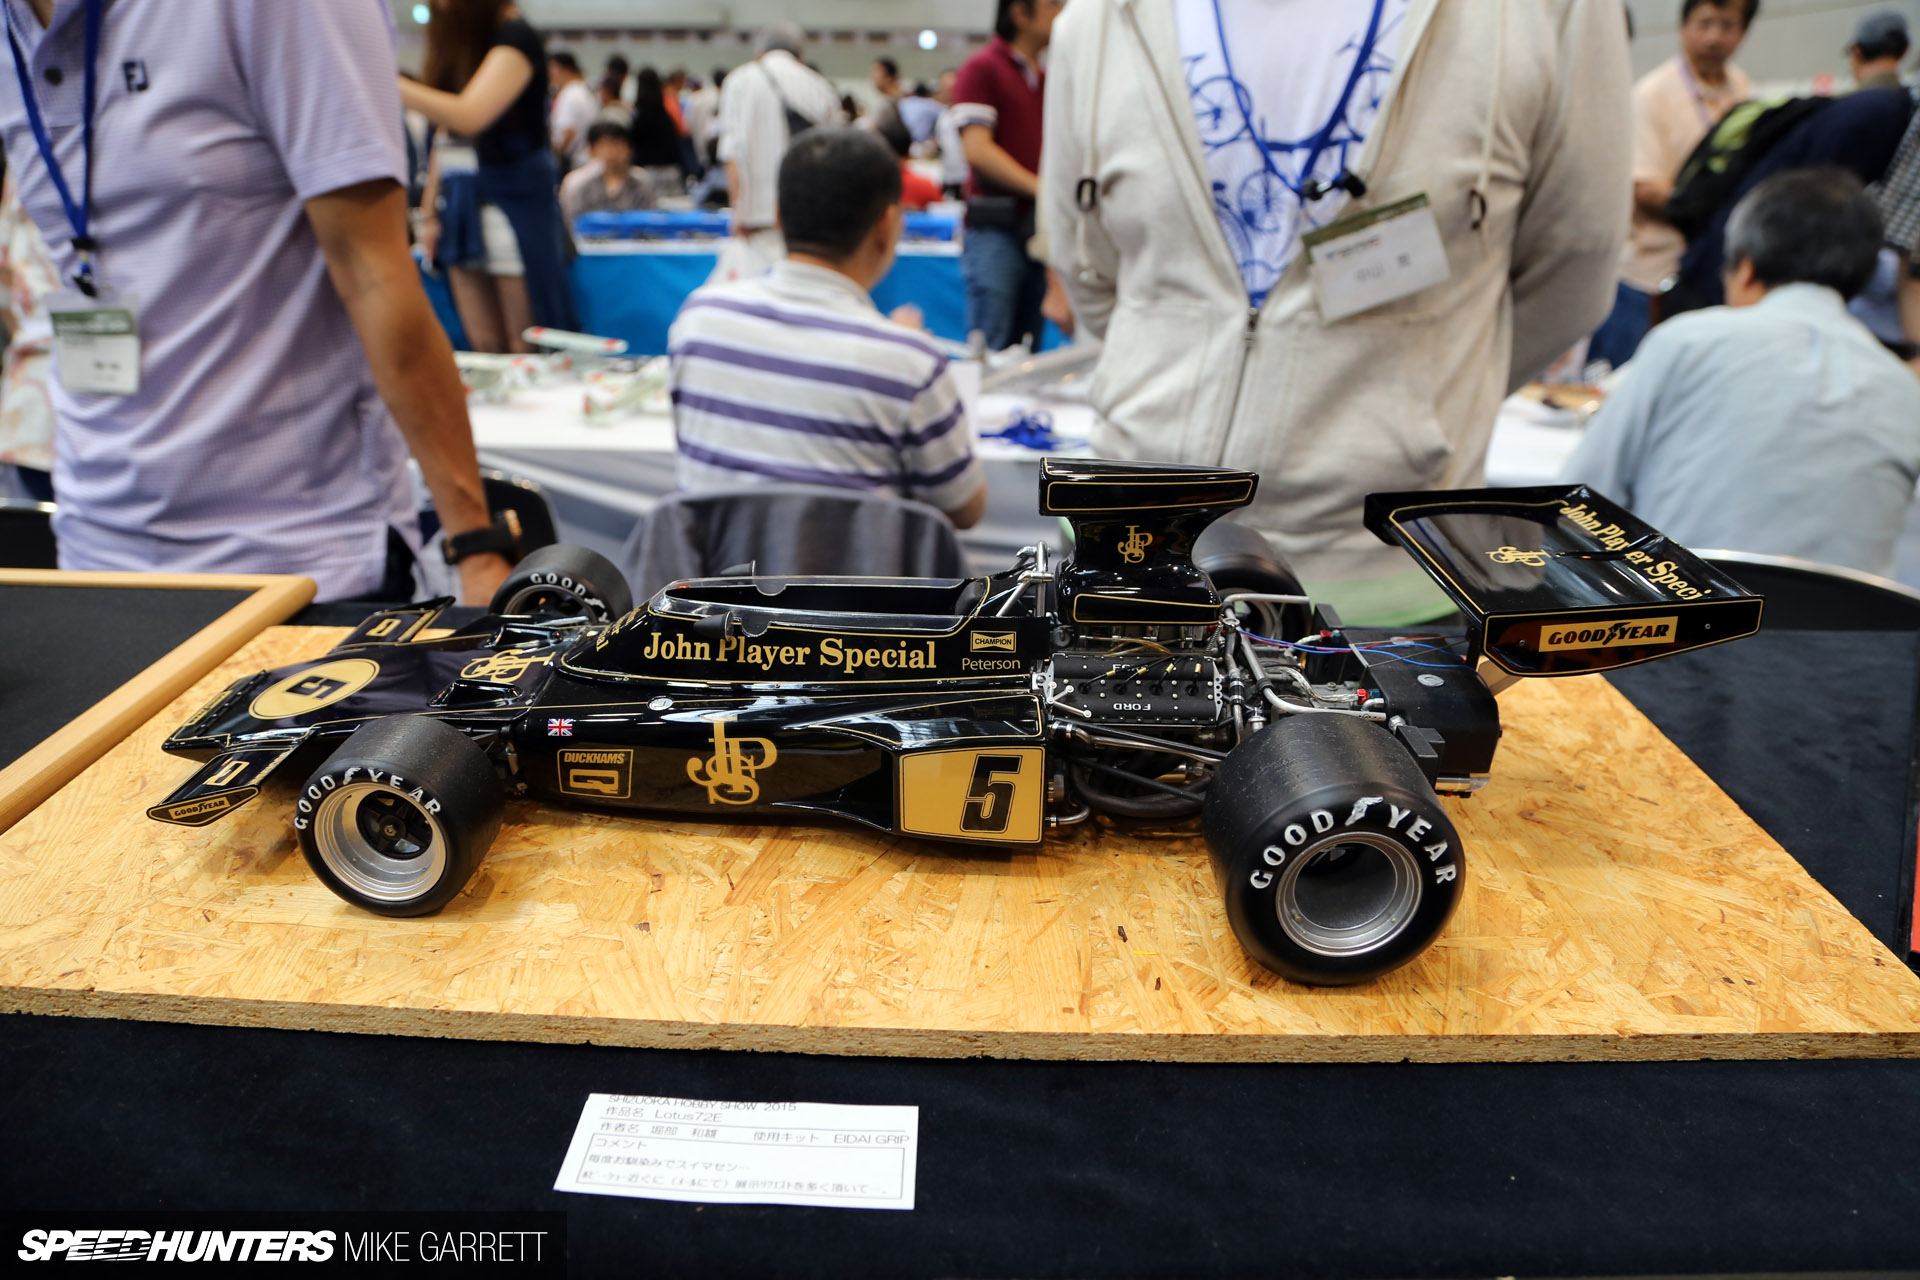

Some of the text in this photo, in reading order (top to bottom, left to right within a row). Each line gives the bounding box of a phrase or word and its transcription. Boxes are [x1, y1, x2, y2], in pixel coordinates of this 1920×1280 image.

[122, 60, 149, 91] FJ
[1559, 503, 1712, 600] John Player Speci
[1548, 622, 1669, 645] GOODYEAR
[643, 632, 936, 674] John Player Special
[961, 657, 1021, 670] Peterson
[1113, 702, 1151, 711] FORD
[563, 752, 625, 765] DUCKHAMS
[960, 753, 1024, 834] 5
[174, 800, 226, 817] GOODYEAR
[608, 1095, 797, 1112] SHIZUOKA HOBBY SHOW 2015
[605, 1105, 724, 1123] 作品名 Lotus72E
[600, 1121, 640, 1134] 作者名
[753, 1131, 820, 1143] 使用キット
[834, 1134, 871, 1144] EIDAI
[875, 1135, 911, 1145] GRIP
[594, 1137, 648, 1150] コメント
